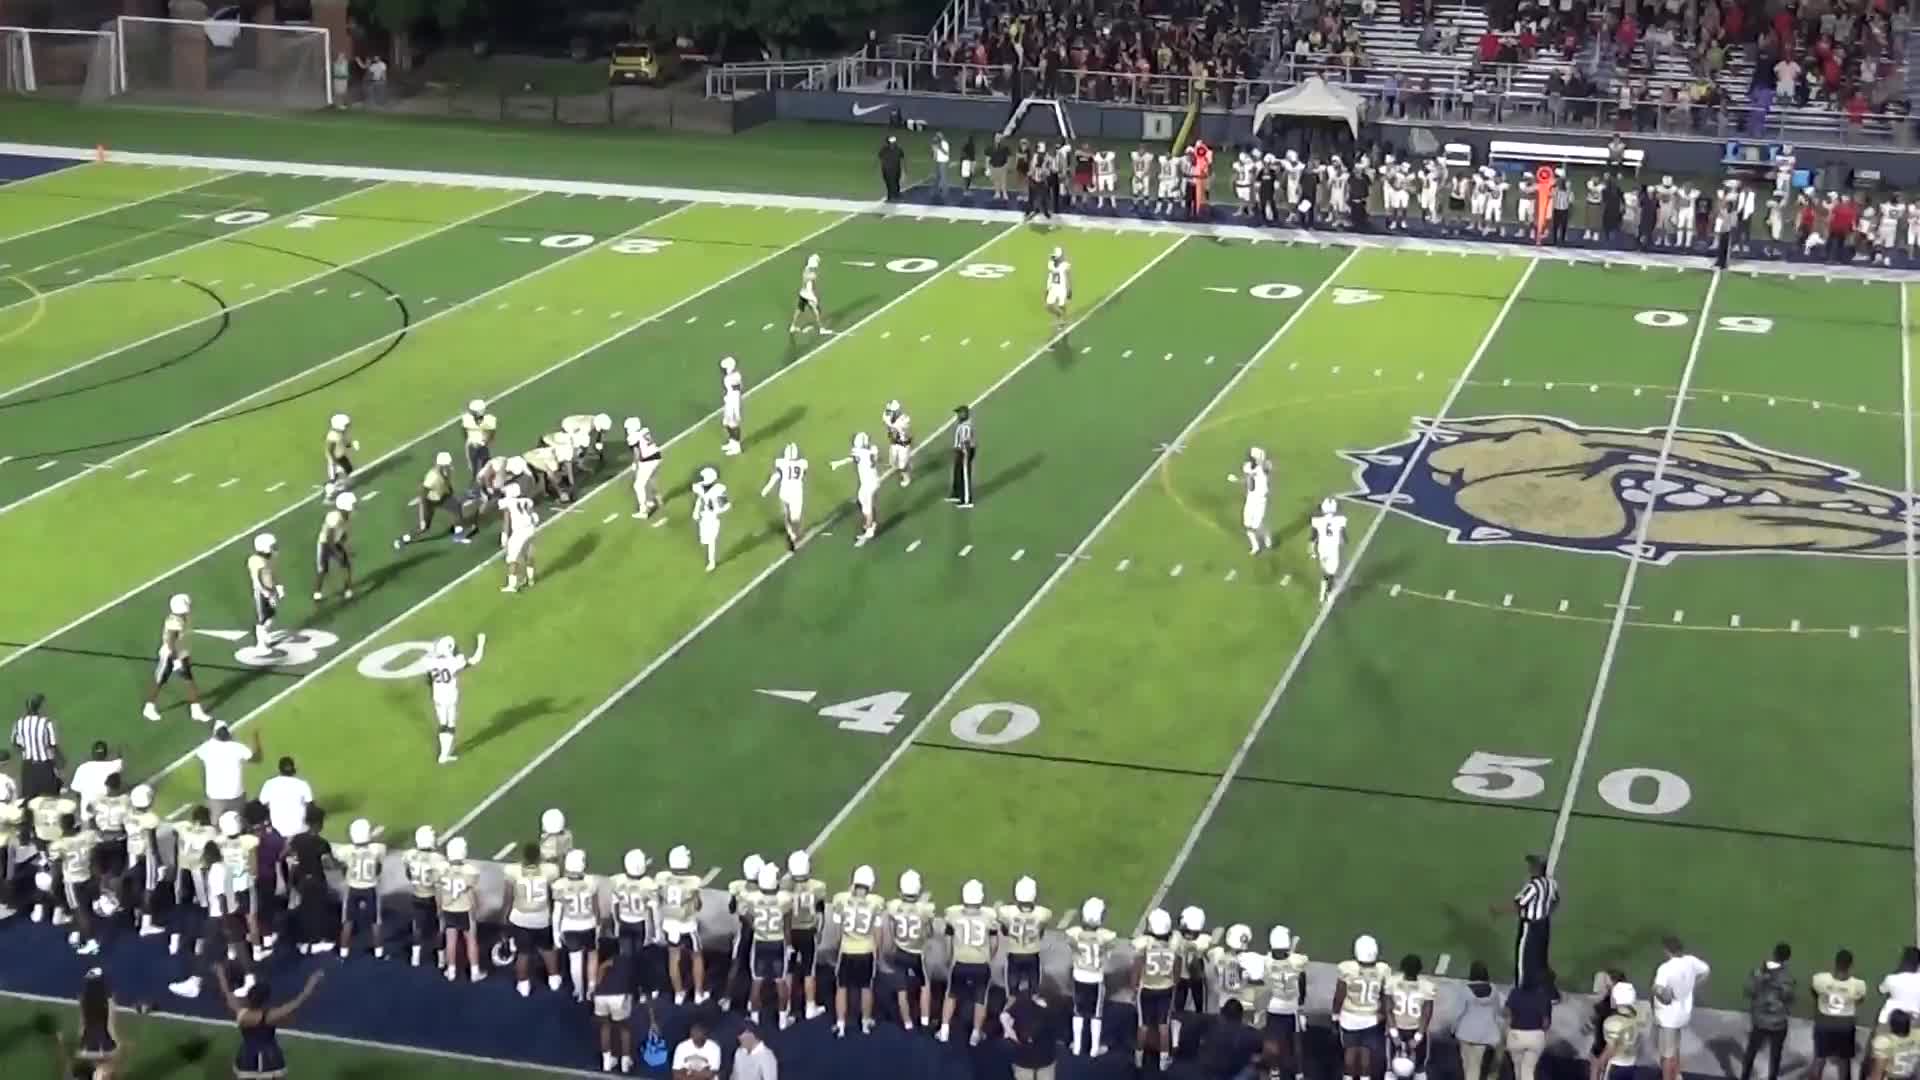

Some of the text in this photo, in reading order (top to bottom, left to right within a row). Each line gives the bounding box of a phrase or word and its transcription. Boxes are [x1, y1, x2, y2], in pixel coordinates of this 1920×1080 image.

[788, 466, 801, 481] 19
[432, 668, 452, 684] 20
[753, 907, 783, 931] 22
[843, 906, 873, 934] 33
[894, 914, 922, 939] 32
[1392, 990, 1424, 1018] 36
